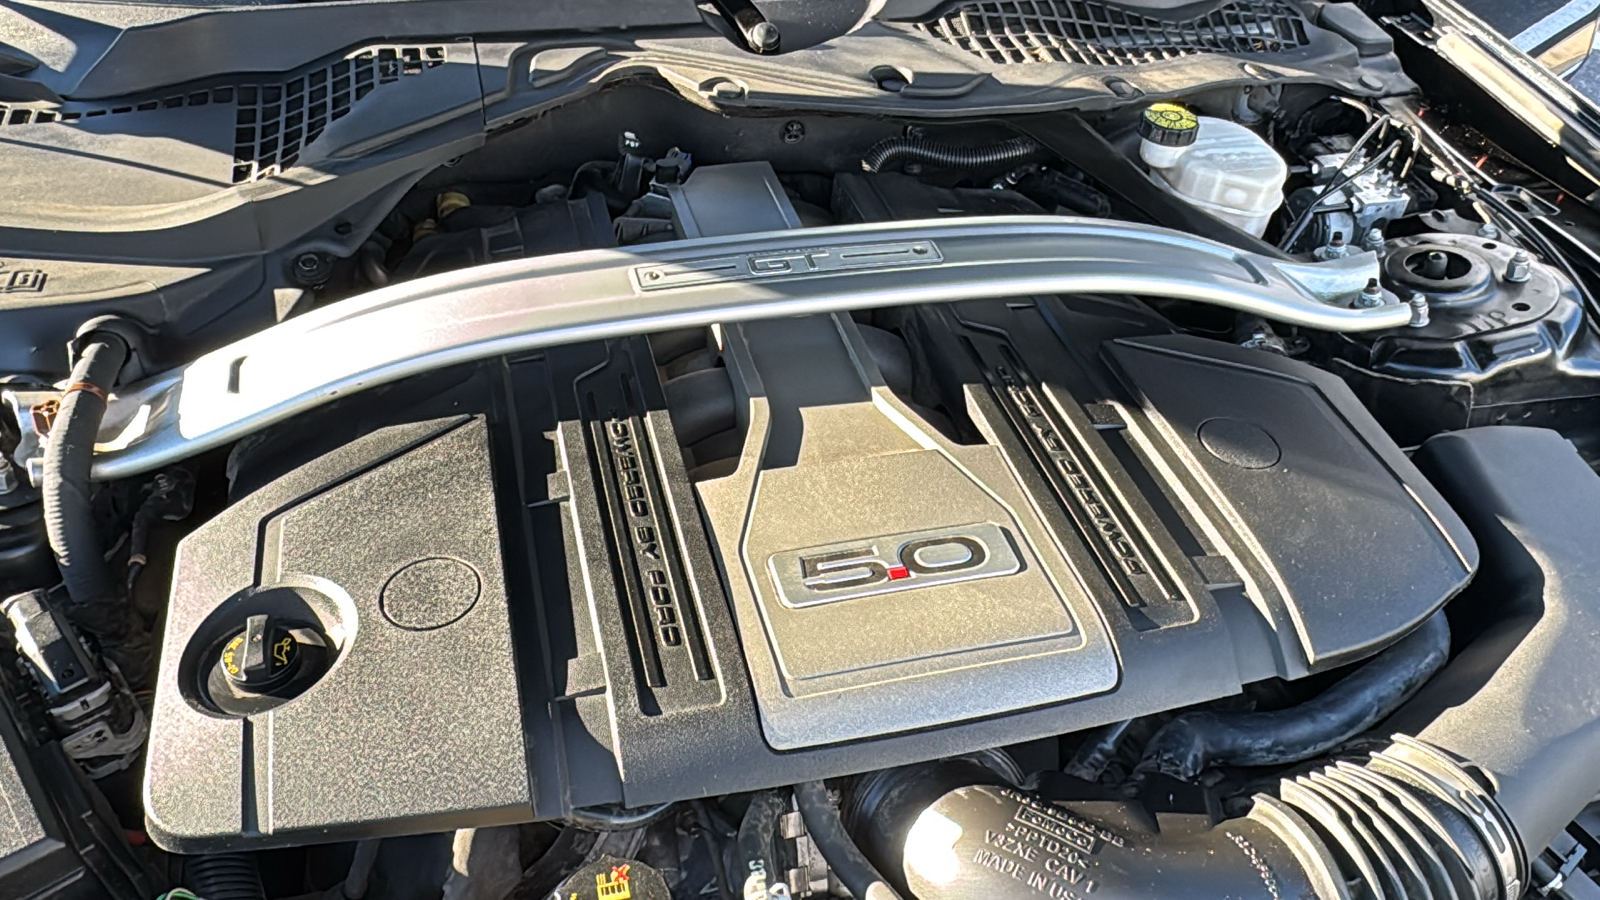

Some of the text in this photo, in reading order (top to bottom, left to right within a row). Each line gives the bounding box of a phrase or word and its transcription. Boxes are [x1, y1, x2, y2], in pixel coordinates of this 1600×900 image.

[746, 247, 829, 276] GT
[634, 526, 661, 560] BY
[799, 534, 991, 592] 5.0
[647, 569, 682, 647] FORD
[1020, 808, 1089, 848] FoMoCo
[972, 848, 1026, 880] MADE
[1026, 871, 1048, 891] IN
[1045, 857, 1084, 885] CAV
